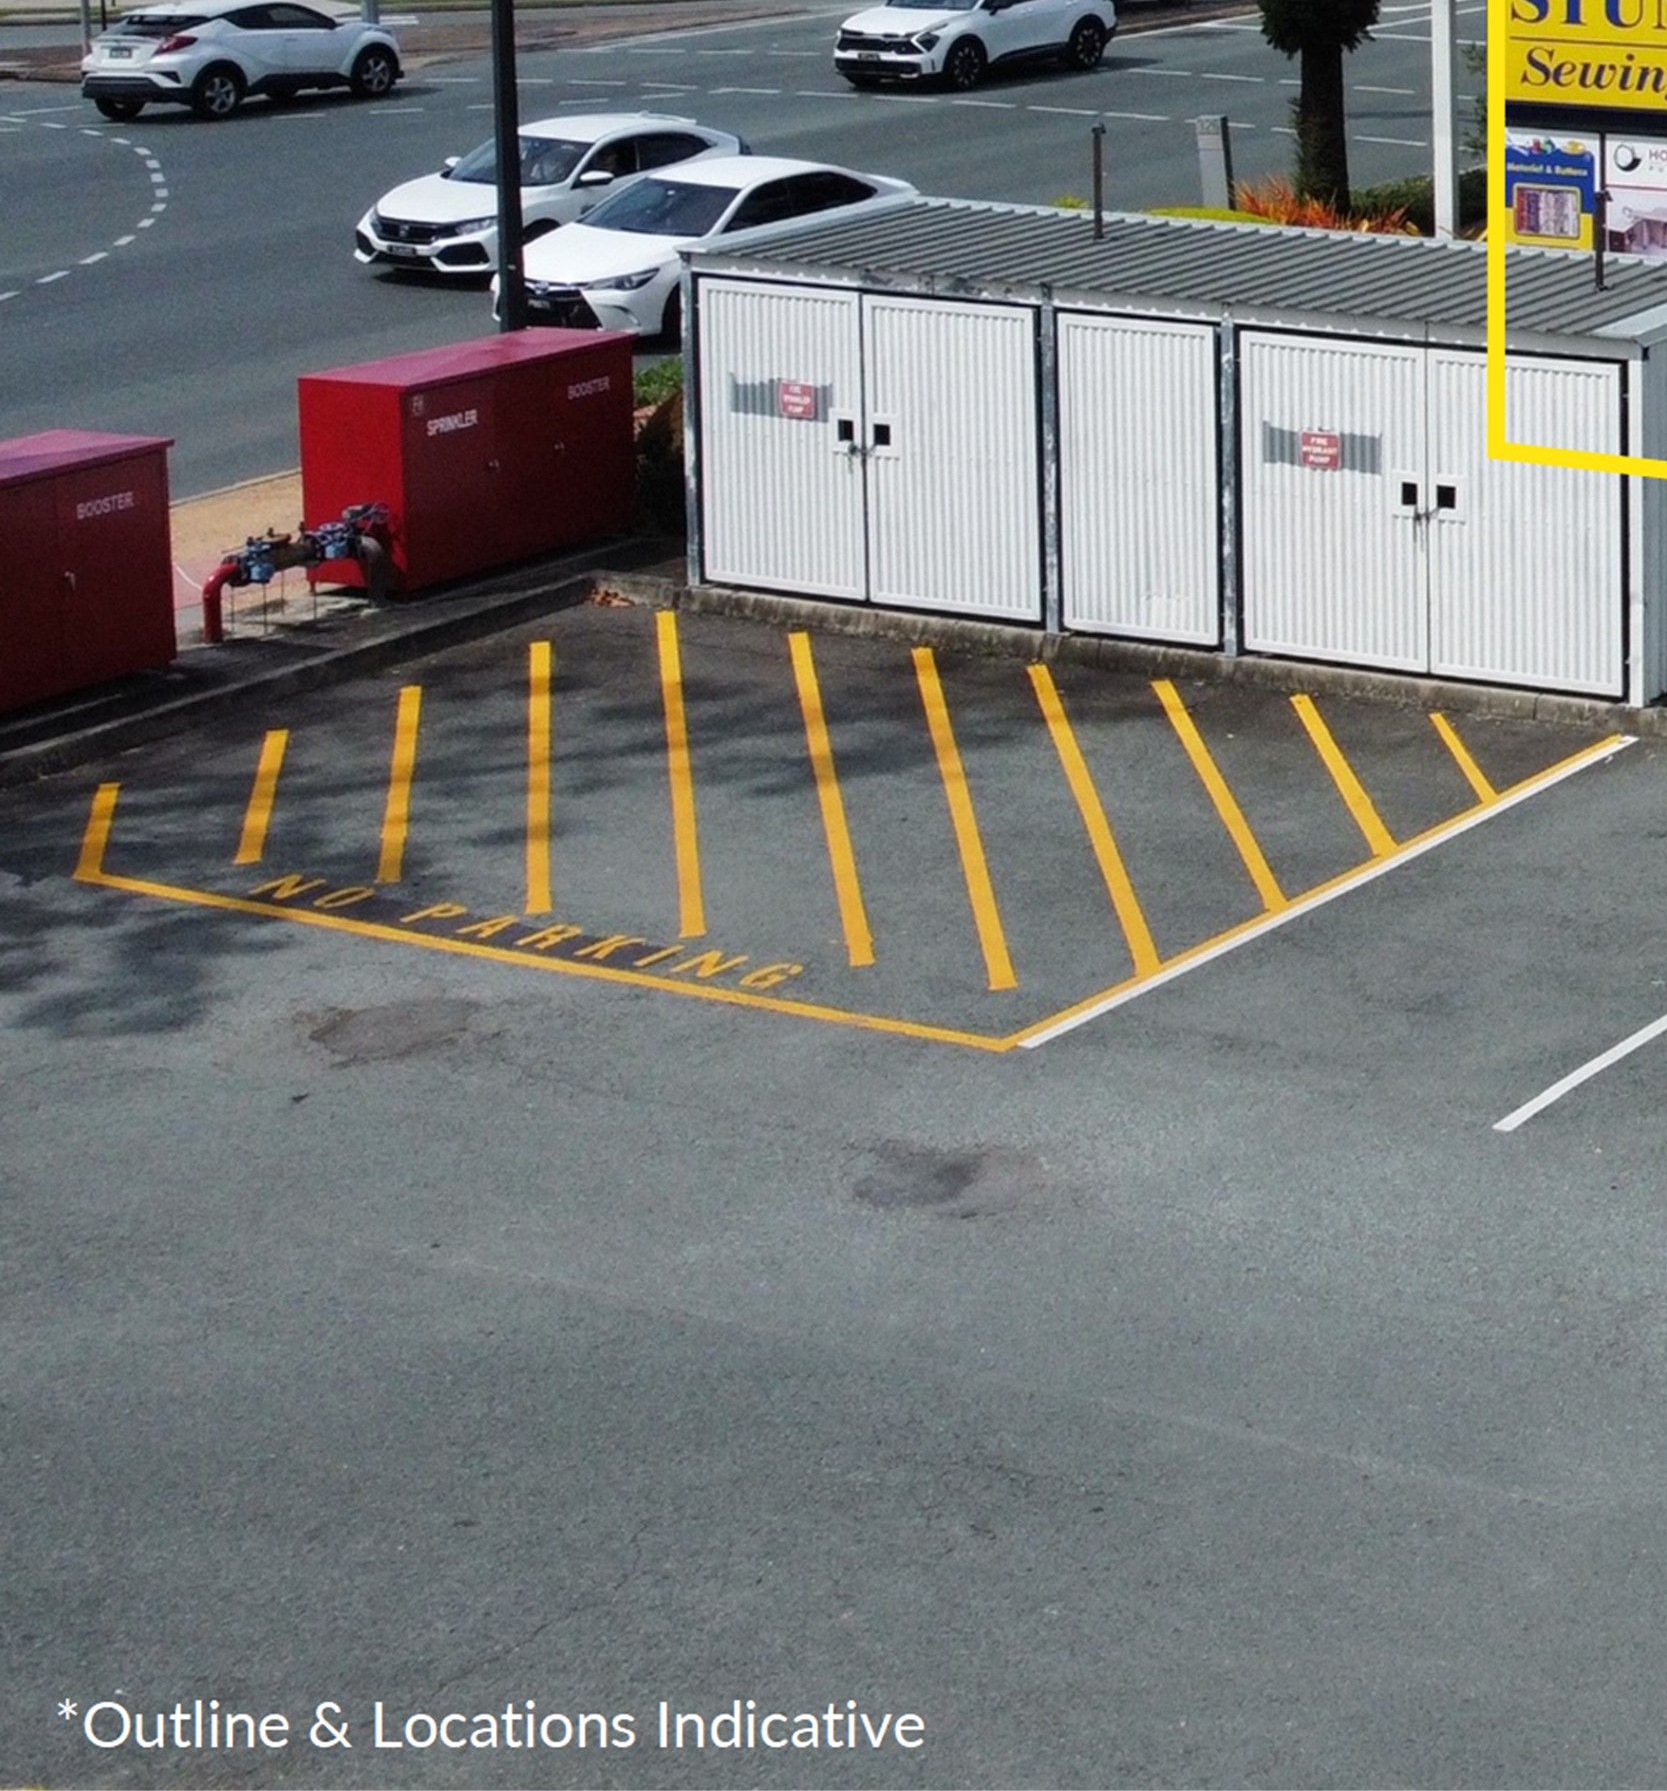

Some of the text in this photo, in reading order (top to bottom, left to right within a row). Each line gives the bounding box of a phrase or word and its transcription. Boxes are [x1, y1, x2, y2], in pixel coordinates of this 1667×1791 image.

[567, 376, 610, 400] BOOSTER
[426, 409, 478, 436] SPRINKLER
[76, 491, 134, 519] BOOSTER
[250, 873, 802, 989] NO PARKING
